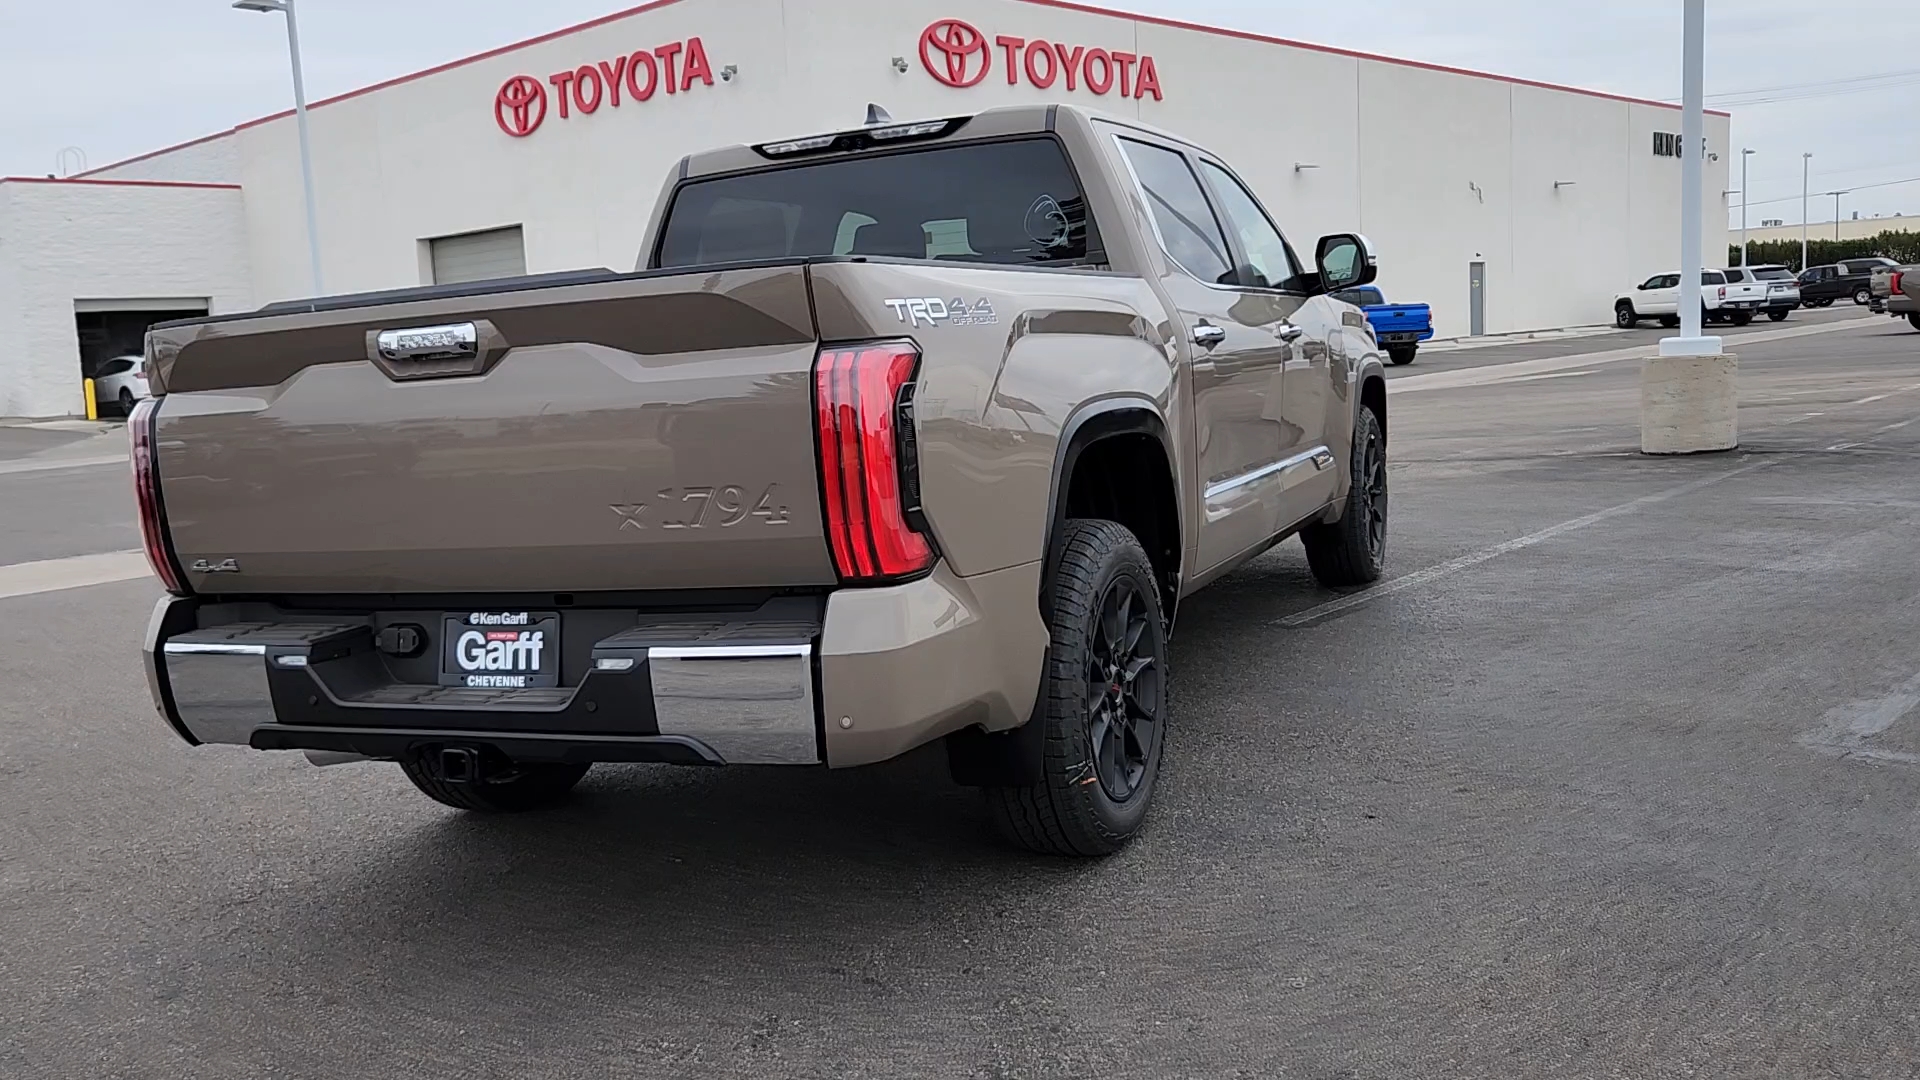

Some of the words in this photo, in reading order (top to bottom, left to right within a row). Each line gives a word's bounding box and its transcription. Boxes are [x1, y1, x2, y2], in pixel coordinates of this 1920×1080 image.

[549, 37, 714, 118] TOYOTA
[996, 36, 1162, 100] TOYOTA
[884, 297, 949, 328] TRD
[657, 482, 791, 529] 1794
[480, 612, 502, 625] Ken
[501, 612, 528, 625] Garff
[456, 630, 544, 671] Garff
[466, 675, 526, 687] CHEYENNE
